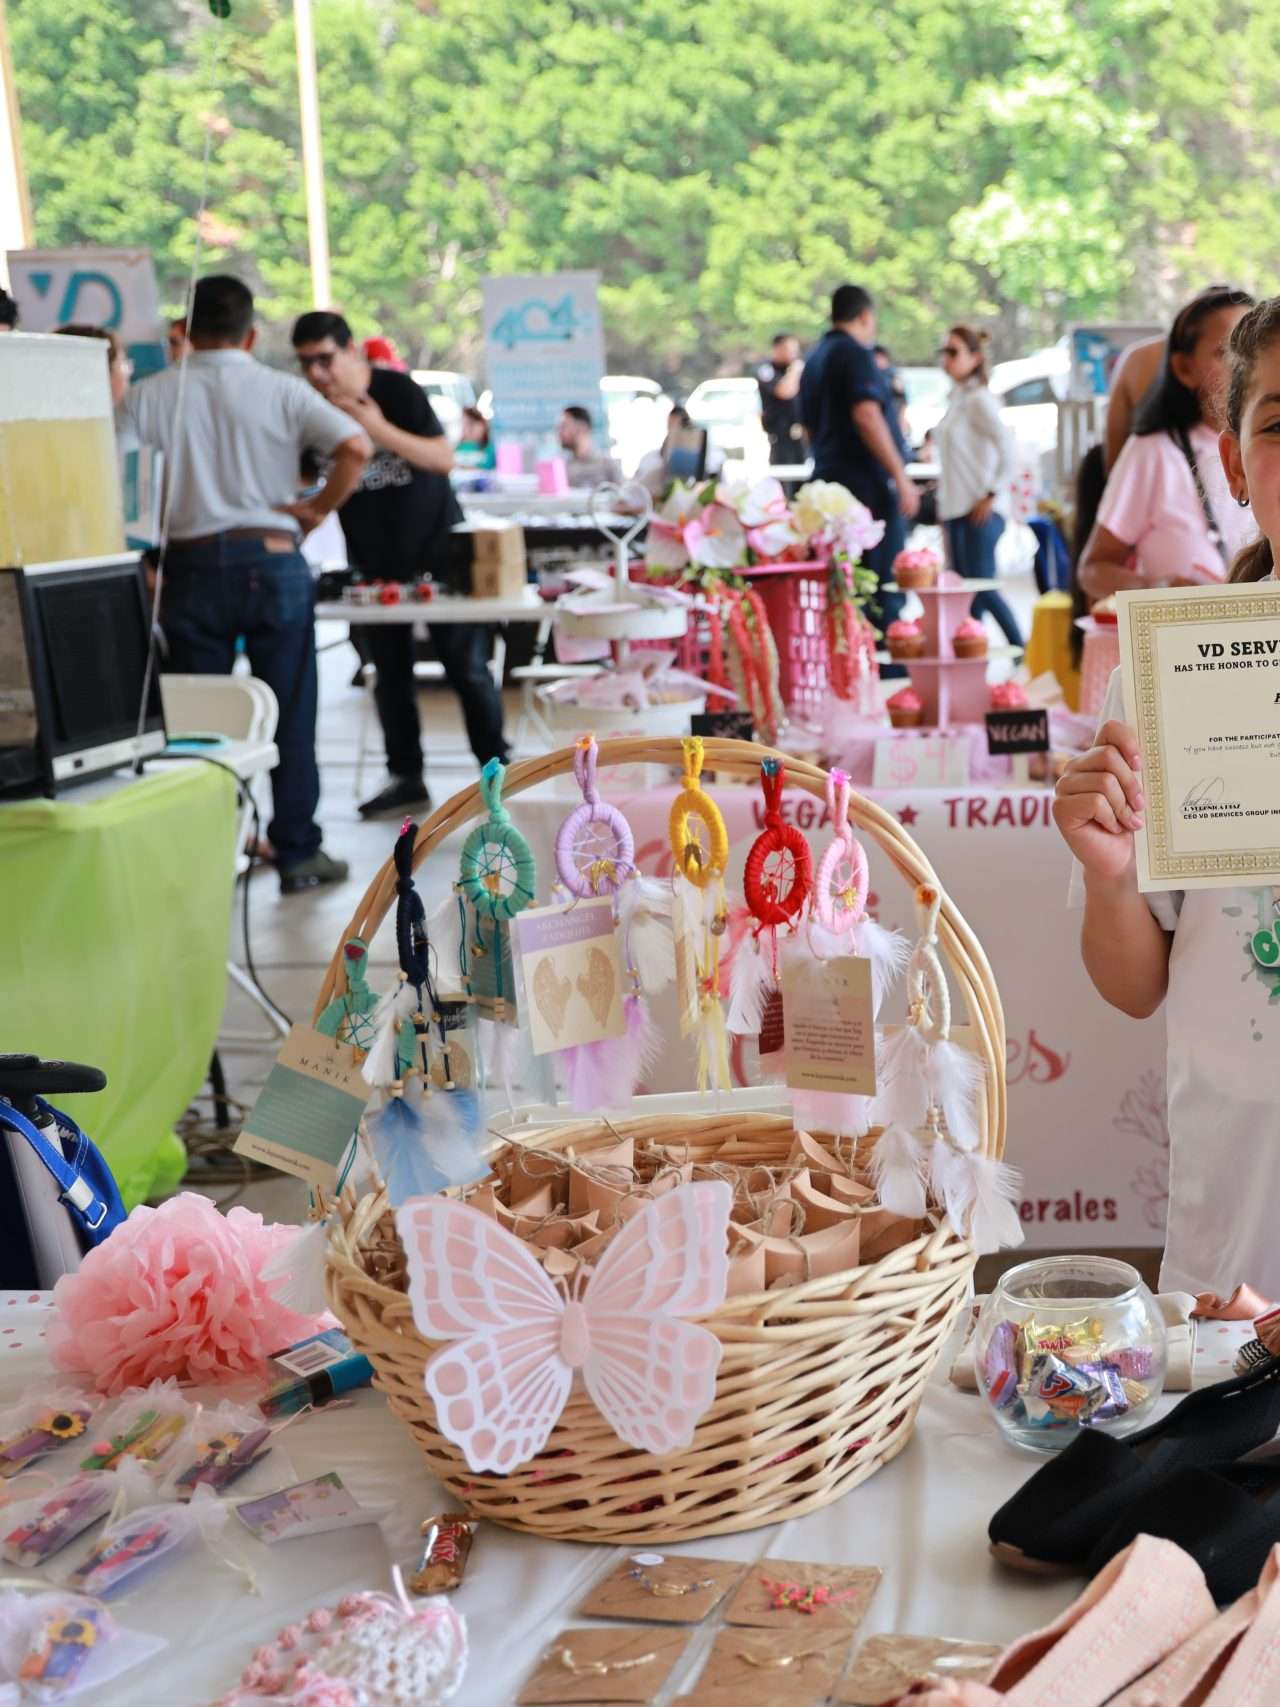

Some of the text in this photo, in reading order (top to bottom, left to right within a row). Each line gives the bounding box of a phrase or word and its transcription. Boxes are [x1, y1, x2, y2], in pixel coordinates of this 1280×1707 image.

[1197, 643, 1225, 658] VD
[1174, 664, 1194, 673] HAS
[1195, 662, 1216, 671] THE
[1218, 660, 1253, 670] HONOR
[1255, 659, 1269, 668] TO
[989, 716, 1046, 742] VEGAN
